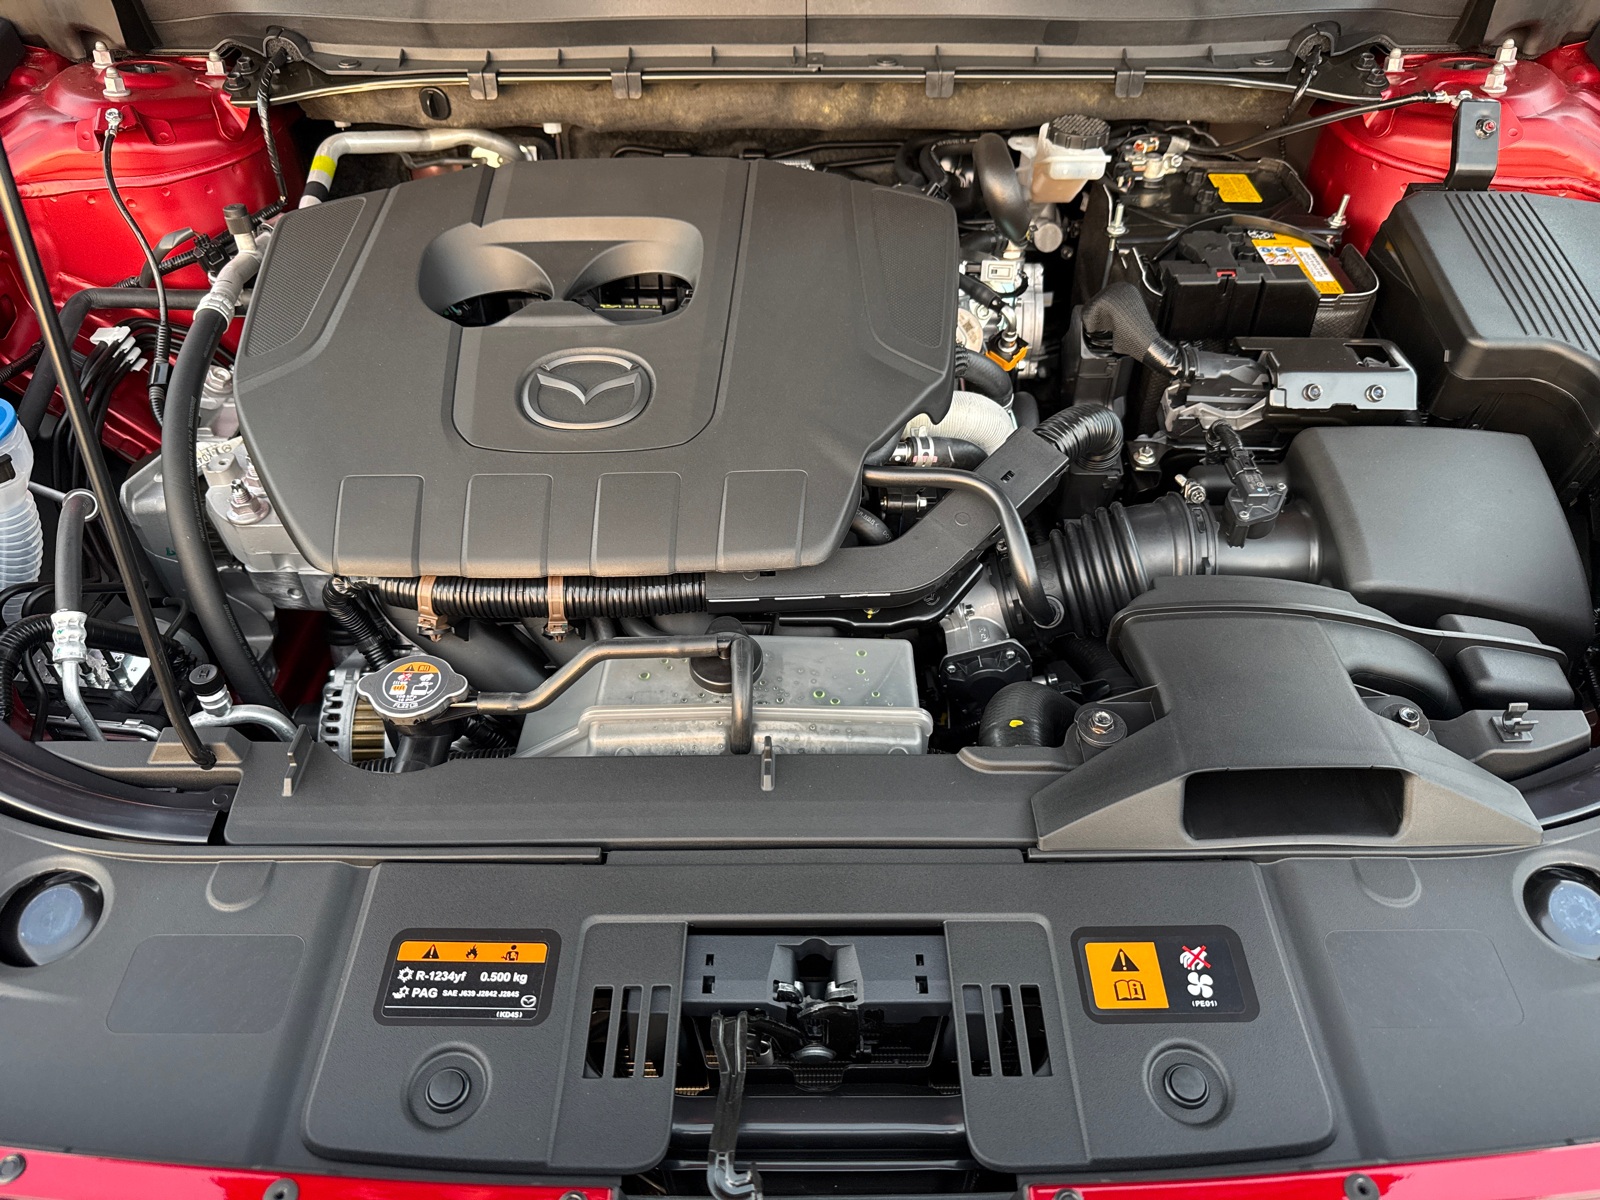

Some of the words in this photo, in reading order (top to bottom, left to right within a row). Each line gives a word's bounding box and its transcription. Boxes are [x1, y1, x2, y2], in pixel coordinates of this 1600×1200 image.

[415, 970, 467, 983] R-1234yf
[480, 971, 511, 982] 0.500
[513, 972, 528, 984] kg
[411, 987, 438, 998] PAG
